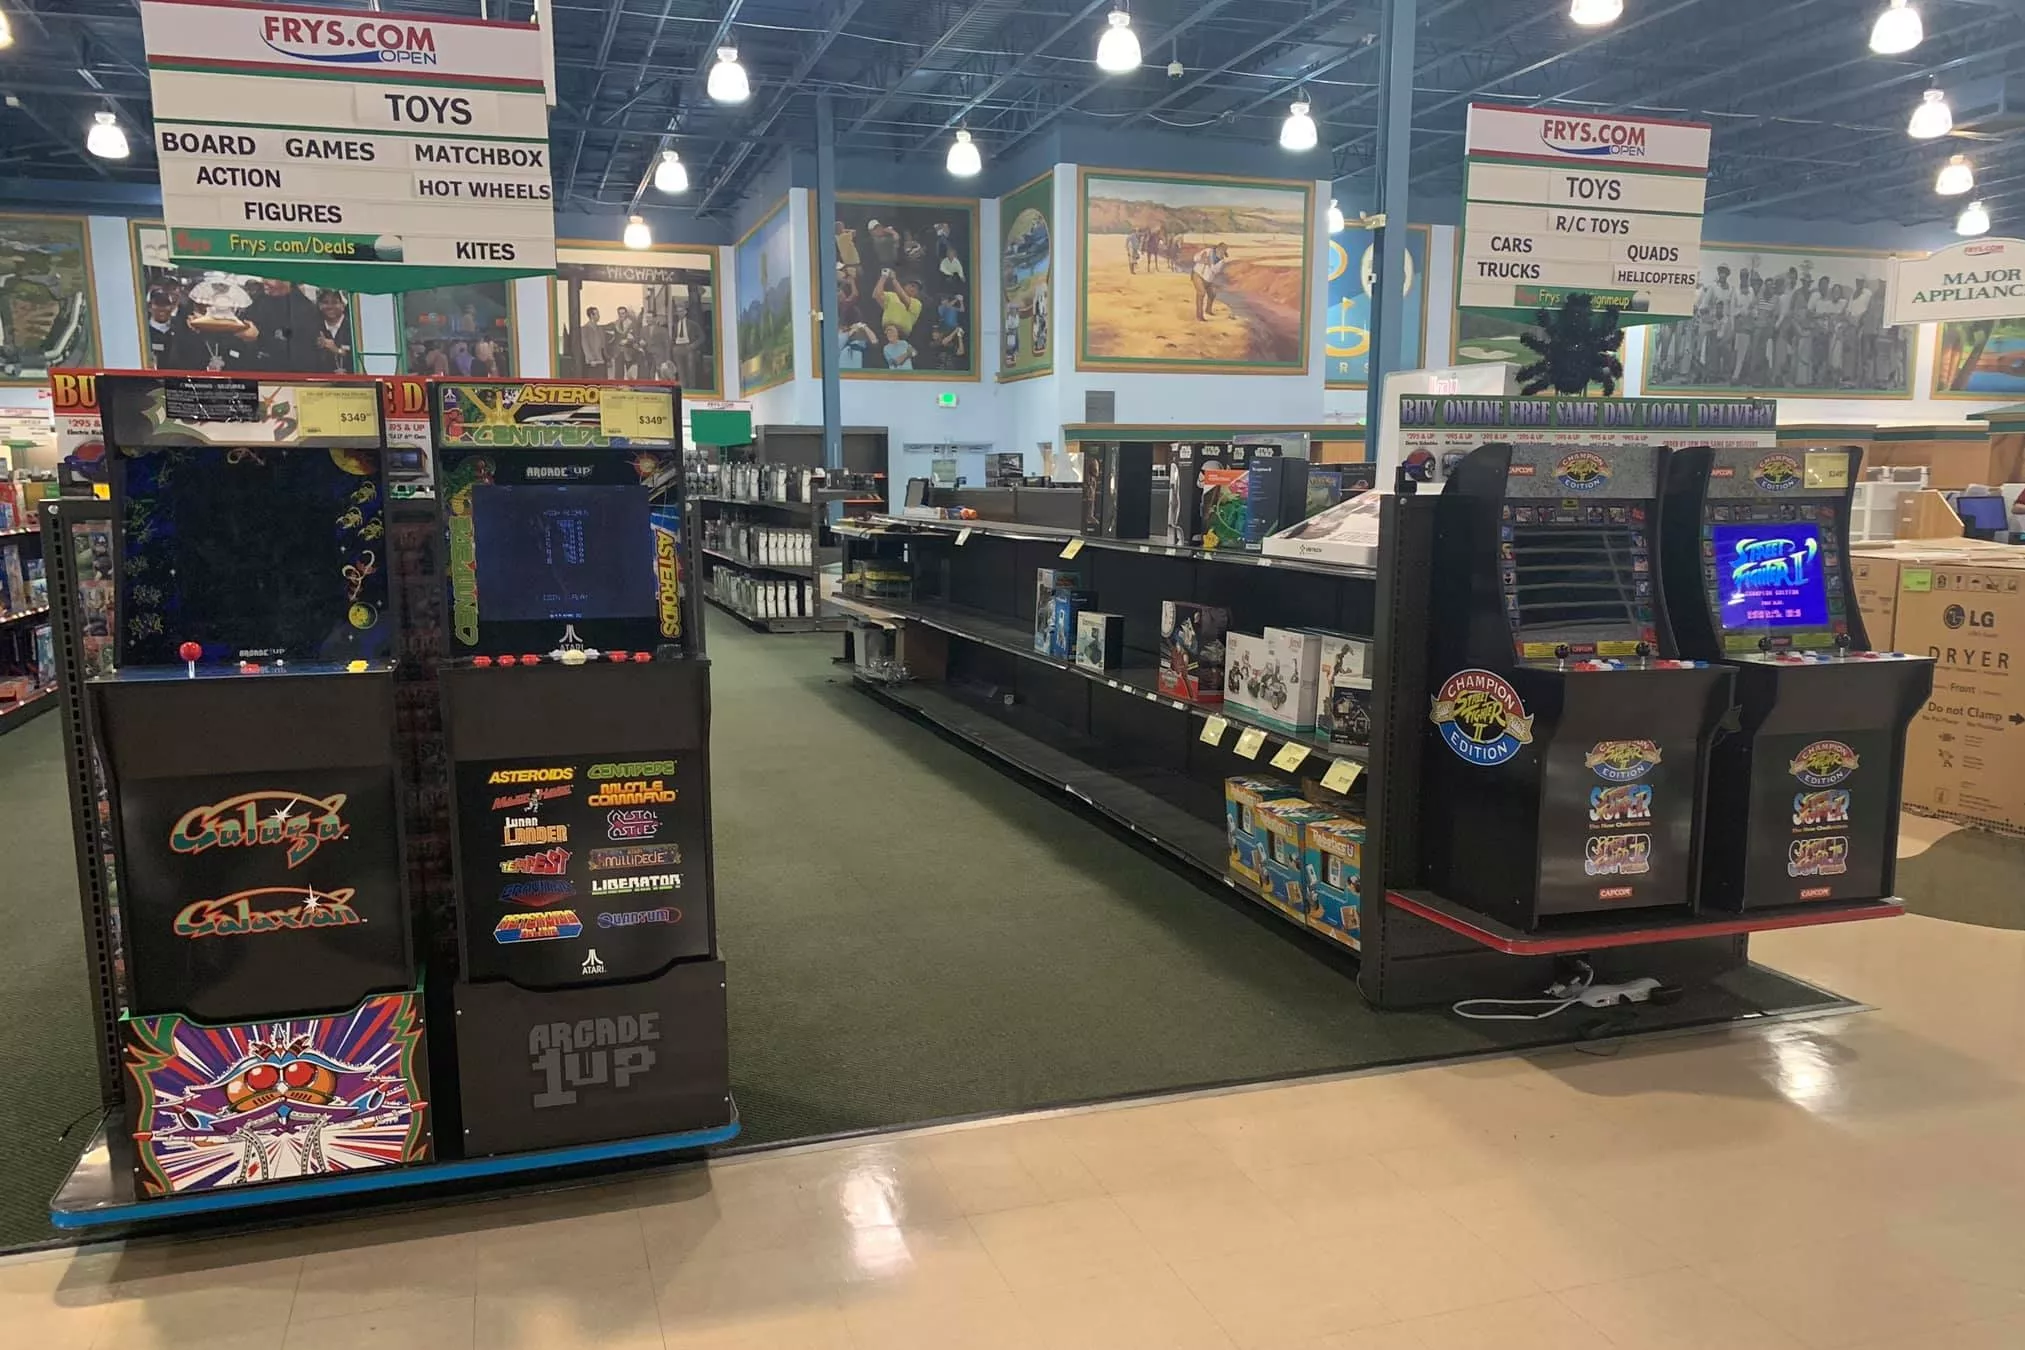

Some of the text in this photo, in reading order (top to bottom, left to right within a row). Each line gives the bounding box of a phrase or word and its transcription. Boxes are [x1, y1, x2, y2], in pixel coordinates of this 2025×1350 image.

[264, 16, 436, 52] FRYS.COM
[381, 50, 437, 65] OPEN
[385, 94, 472, 125] TOYS
[1543, 119, 1646, 146] FRYS.COM
[162, 132, 375, 161] BOARD GAMES
[415, 144, 543, 167] MATCHBOX
[1609, 145, 1646, 156] OPEN
[197, 166, 281, 188] ACTION
[419, 179, 551, 201] HOT WHEELS
[1566, 176, 1622, 201] TOYS
[244, 201, 343, 224] FIGURES
[1556, 216, 1630, 234] R/C TOYS
[456, 241, 515, 261] KITES
[1491, 236, 1533, 253] CARS
[1627, 244, 1679, 262] QUADS
[1477, 262, 1541, 279] TRUCKS
[1617, 270, 1696, 285] HELICOPTERS
[1943, 268, 2022, 286] MAJOR
[1912, 284, 2025, 303] APPLIANC
[53, 374, 97, 408] BU
[519, 385, 600, 402] ASTERO
[1401, 400, 1775, 428] BUY ONLINE FREE SAME DAY LOCAL DELIVERY
[1562, 452, 1603, 465] CHAMPION
[1759, 455, 1798, 468] CHAMPION
[526, 466, 568, 478] ARCADE
[1509, 466, 1533, 475] APCOM
[1761, 481, 1794, 491] EDITION
[653, 527, 681, 639] ASTEROIDS
[1969, 610, 1994, 628] LG
[1929, 646, 2009, 669] DRYER
[1447, 675, 1516, 710] CHAMPION
[1950, 683, 1976, 694] Front
[1928, 701, 1944, 712] Do
[1946, 705, 1963, 716] not
[1967, 707, 2002, 723] Clamp
[1450, 731, 1508, 760] EDITION
[488, 767, 573, 784] ASTEROIDS
[587, 760, 675, 779] CENTIPEDE
[1602, 766, 1645, 779] EDITION
[1804, 772, 1844, 784] EDITION
[588, 791, 676, 807] COMMAND
[506, 817, 538, 827] LUNAR
[607, 809, 658, 825] CRYSTAL
[170, 790, 349, 869] Galaga
[503, 825, 568, 846] LANDER
[500, 847, 570, 875] TEMPEST
[592, 874, 681, 893] LIBERATOR
[1600, 888, 1631, 897] CAPCOM
[1801, 888, 1830, 897] CAPCOM
[174, 887, 360, 939] Galaxian
[582, 966, 604, 975] ATARI
[529, 1012, 661, 1054] ARCADE
[532, 1045, 656, 1108] 1UP
